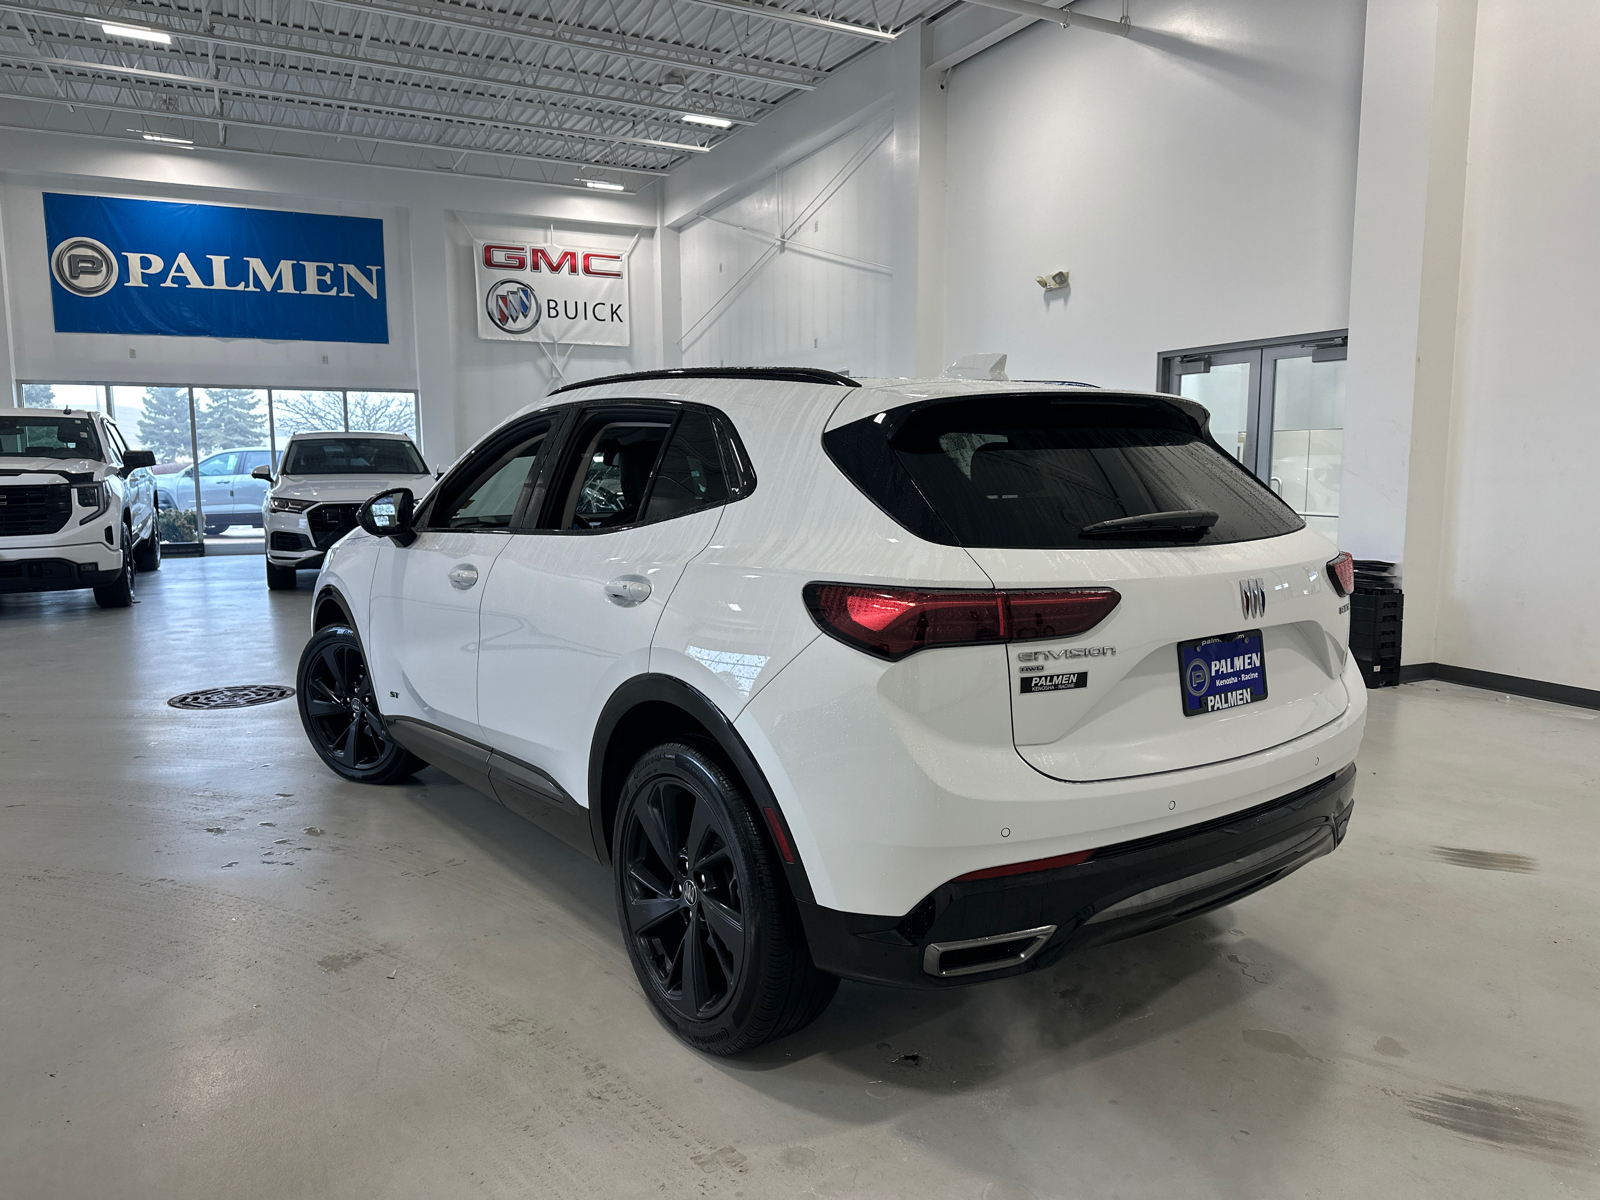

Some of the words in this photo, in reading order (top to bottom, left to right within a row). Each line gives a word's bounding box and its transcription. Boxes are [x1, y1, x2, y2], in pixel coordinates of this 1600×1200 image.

[483, 243, 623, 279] GMC
[121, 252, 382, 300] PALMEN
[547, 299, 624, 323] BUICK
[1020, 665, 1044, 673] AWD
[1211, 652, 1261, 676] PALMEN
[1031, 674, 1078, 687] PALMEN
[1215, 676, 1238, 687] Kenosha
[1241, 672, 1259, 682] Racine
[389, 691, 401, 699] ST
[1207, 688, 1252, 712] PALMEN
